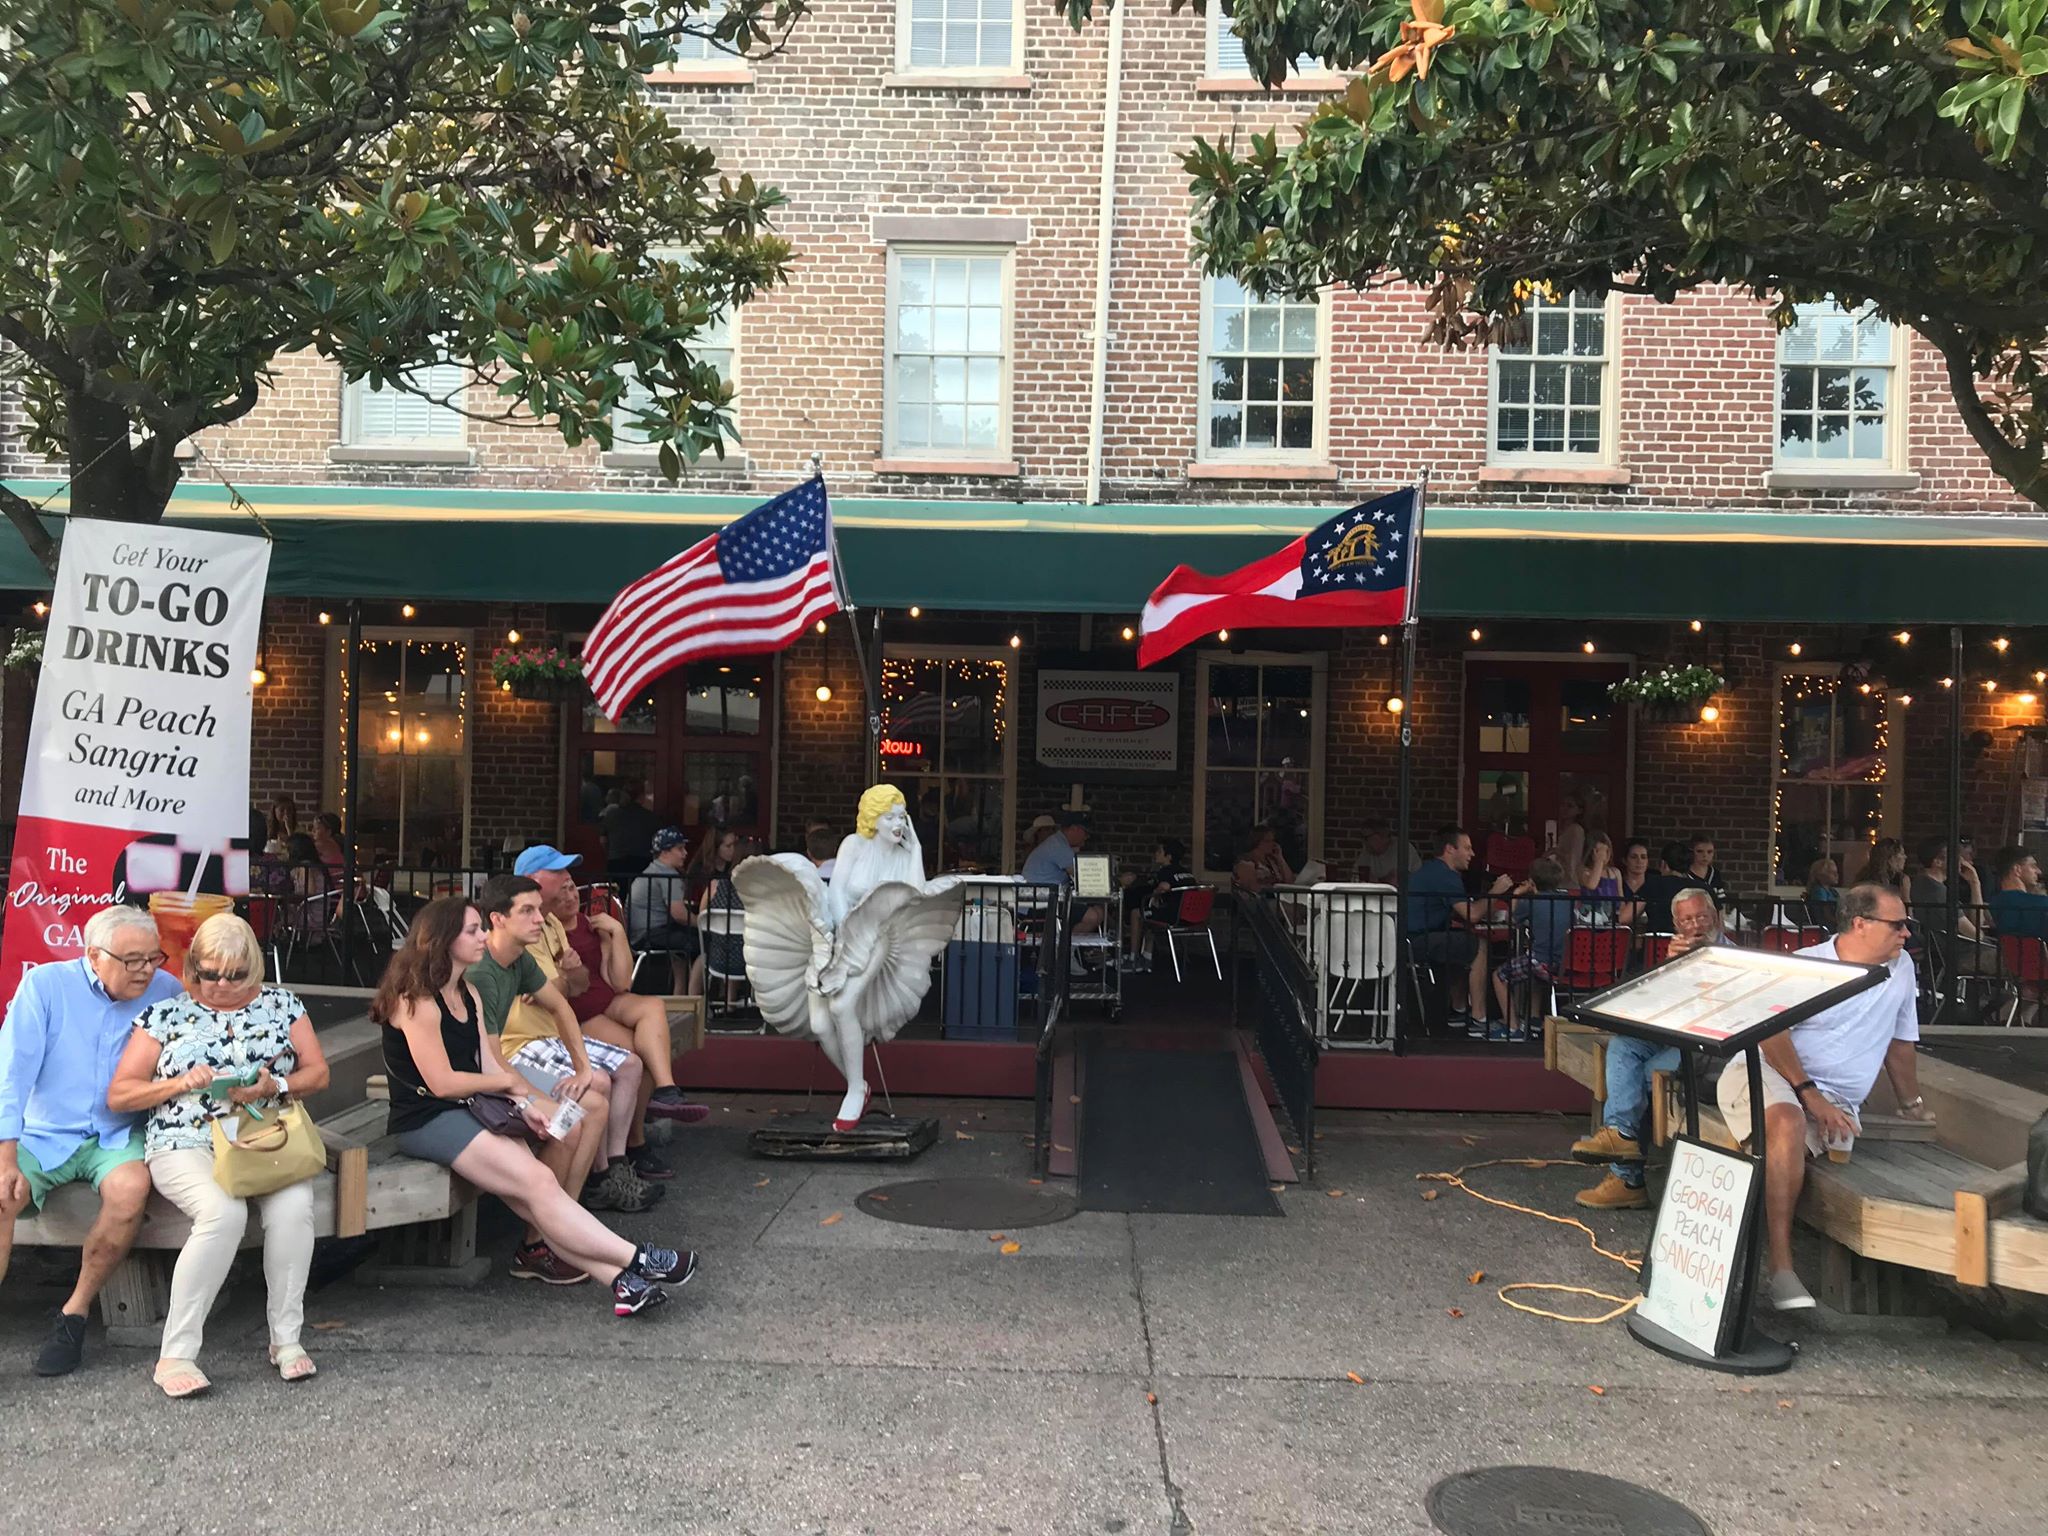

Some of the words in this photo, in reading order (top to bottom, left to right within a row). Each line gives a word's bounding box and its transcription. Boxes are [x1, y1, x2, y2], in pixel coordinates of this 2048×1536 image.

[112, 543, 150, 568] Get
[152, 547, 208, 575] Your
[83, 573, 229, 627] TO-GO
[63, 625, 230, 679] DRINKS
[62, 689, 106, 724] GA
[114, 696, 217, 738] Peach
[69, 733, 198, 778] Sangria
[74, 785, 119, 808] and
[123, 788, 186, 815] More
[46, 846, 88, 875] The
[14, 881, 125, 915] Original
[43, 923, 86, 947] GA
[1682, 1151, 1735, 1192] TO-GO
[1670, 1179, 1733, 1227] GEORGIA
[1674, 1210, 1723, 1252] PEACH
[1653, 1233, 1725, 1294] SANGRIA
